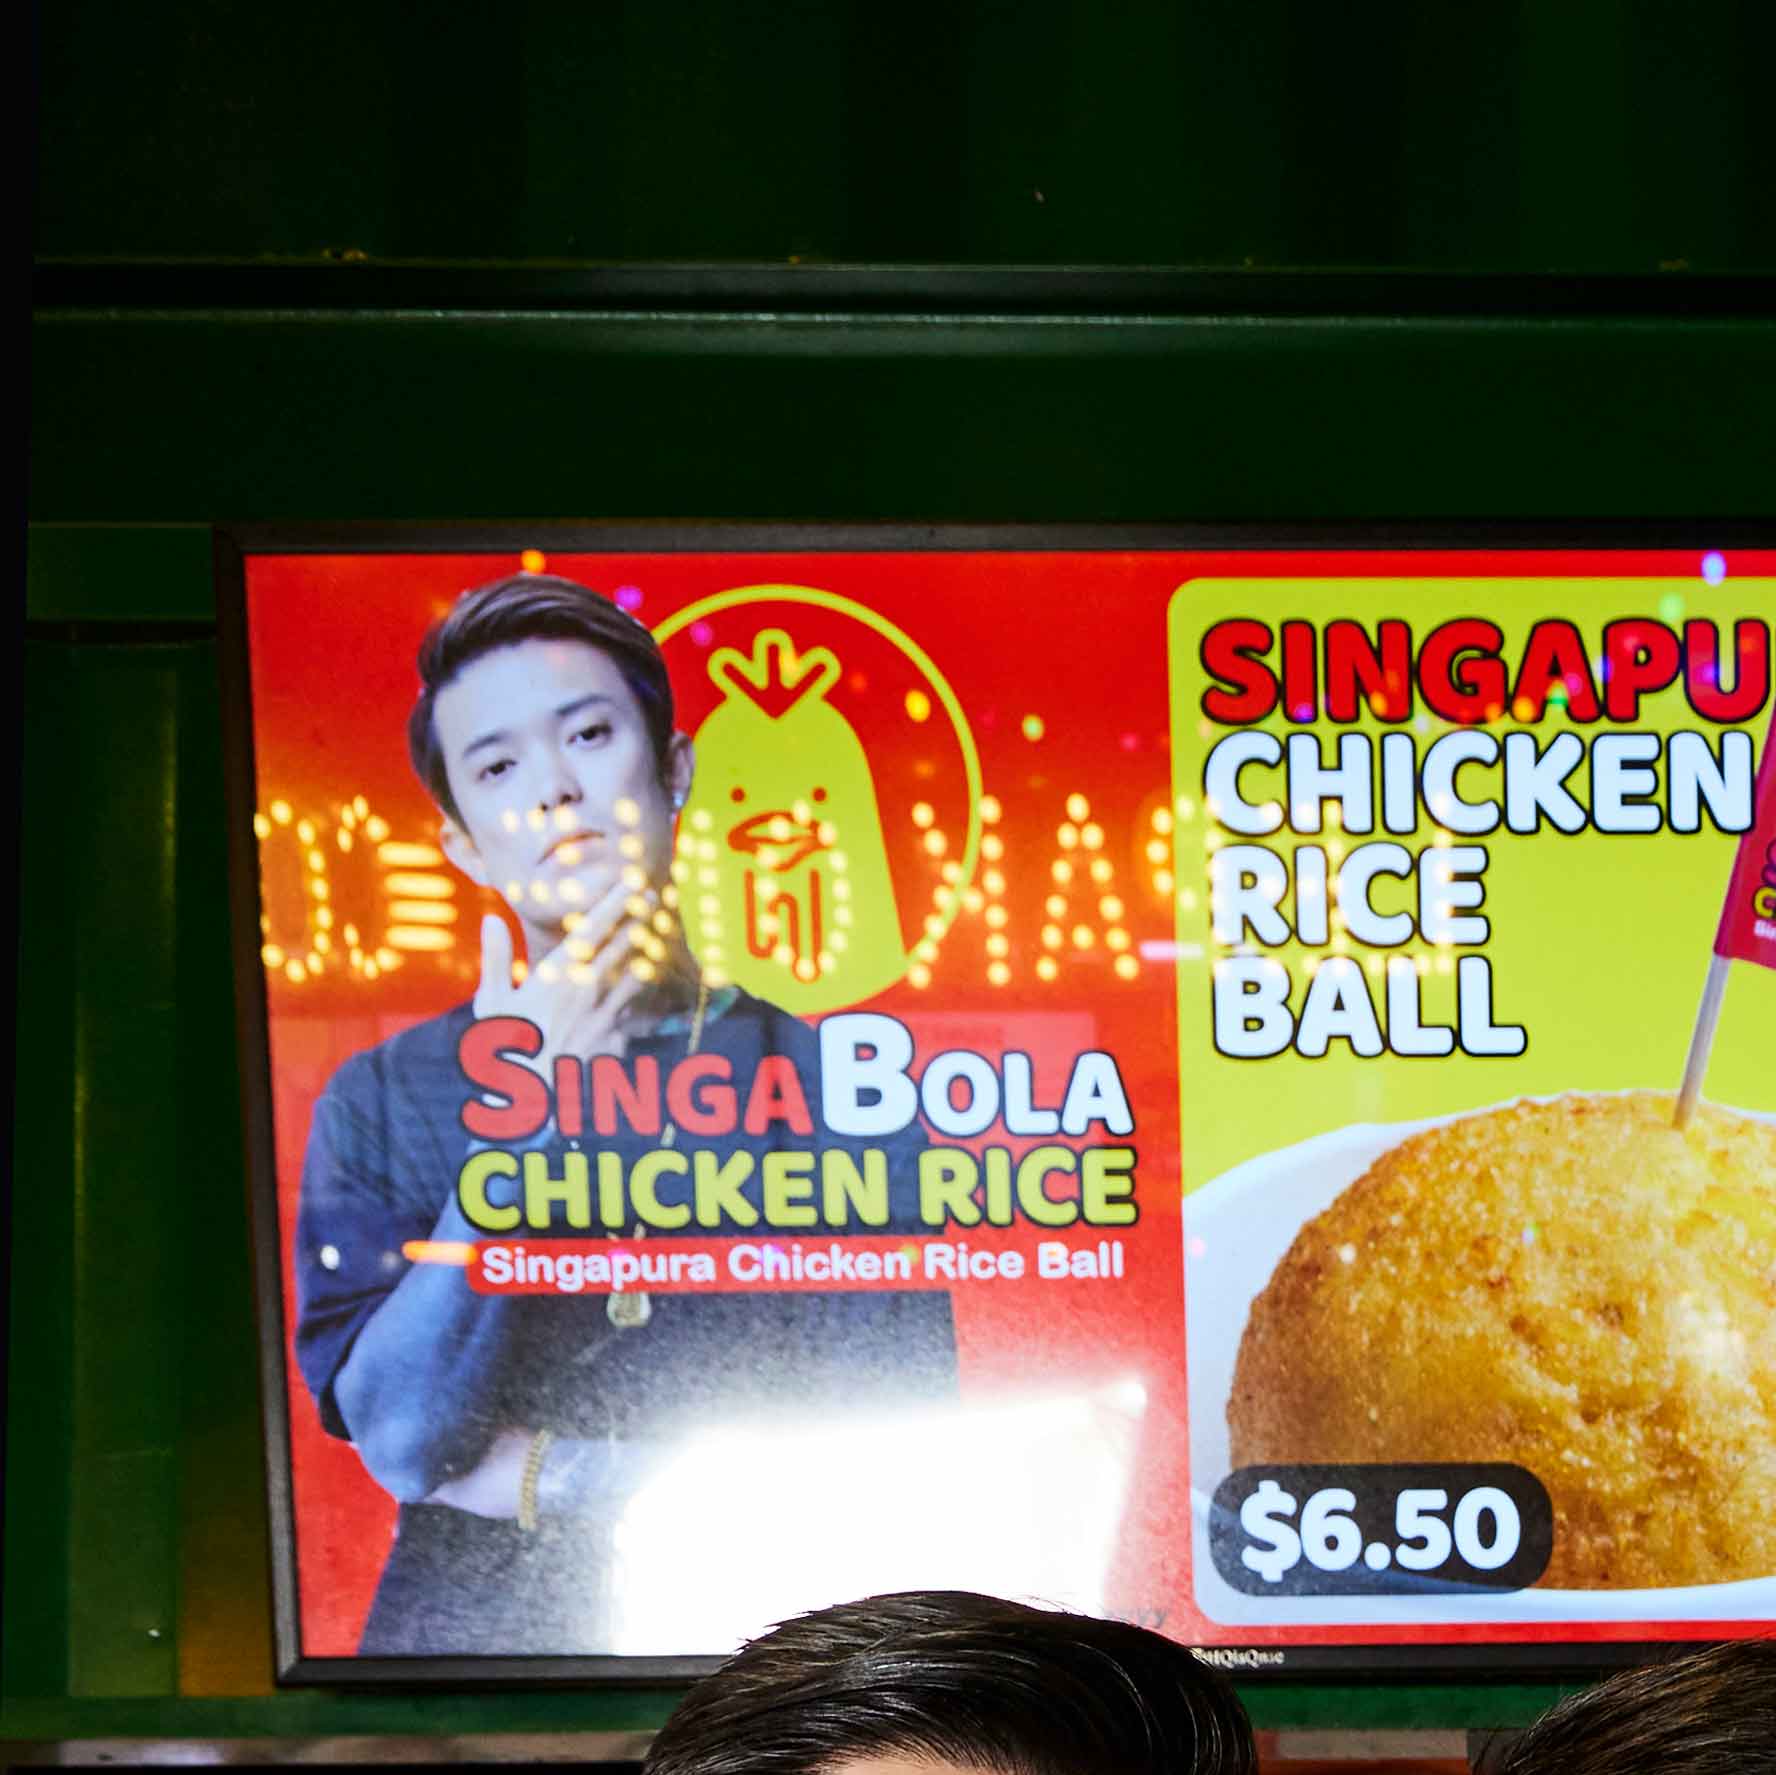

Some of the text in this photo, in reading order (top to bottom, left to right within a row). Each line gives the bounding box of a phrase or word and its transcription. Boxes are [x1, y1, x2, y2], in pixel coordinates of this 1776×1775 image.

[1203, 730, 1755, 834] CHICKEN
[1210, 843, 1489, 946] RICE
[1212, 956, 1527, 1058] BALL
[458, 1145, 1139, 1231] CHICKEN RICE
[482, 1243, 1125, 1289] Singapura Chicken Rice Ball
[1241, 1479, 1521, 1584] $6.50
